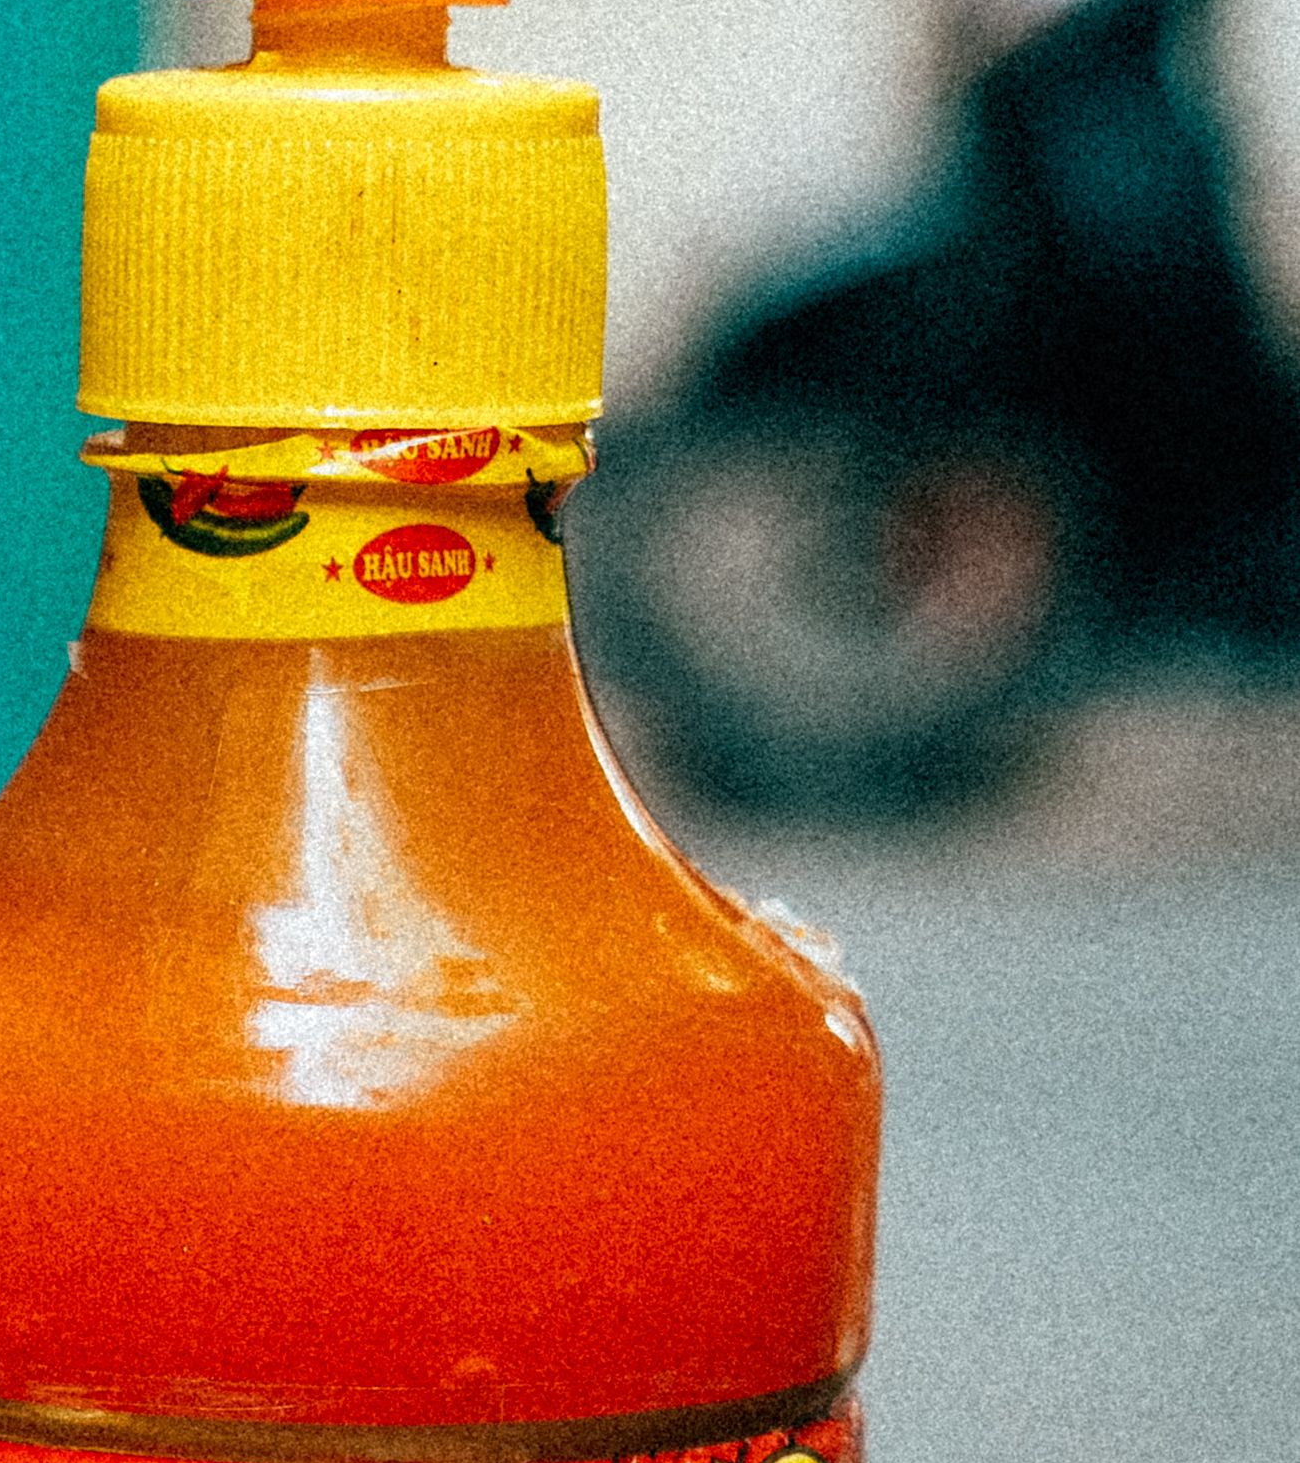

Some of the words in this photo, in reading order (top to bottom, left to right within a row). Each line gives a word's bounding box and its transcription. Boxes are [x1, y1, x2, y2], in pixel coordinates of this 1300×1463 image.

[426, 431, 493, 460] SANH
[362, 545, 413, 588] HẬU
[418, 548, 470, 578] SANH
